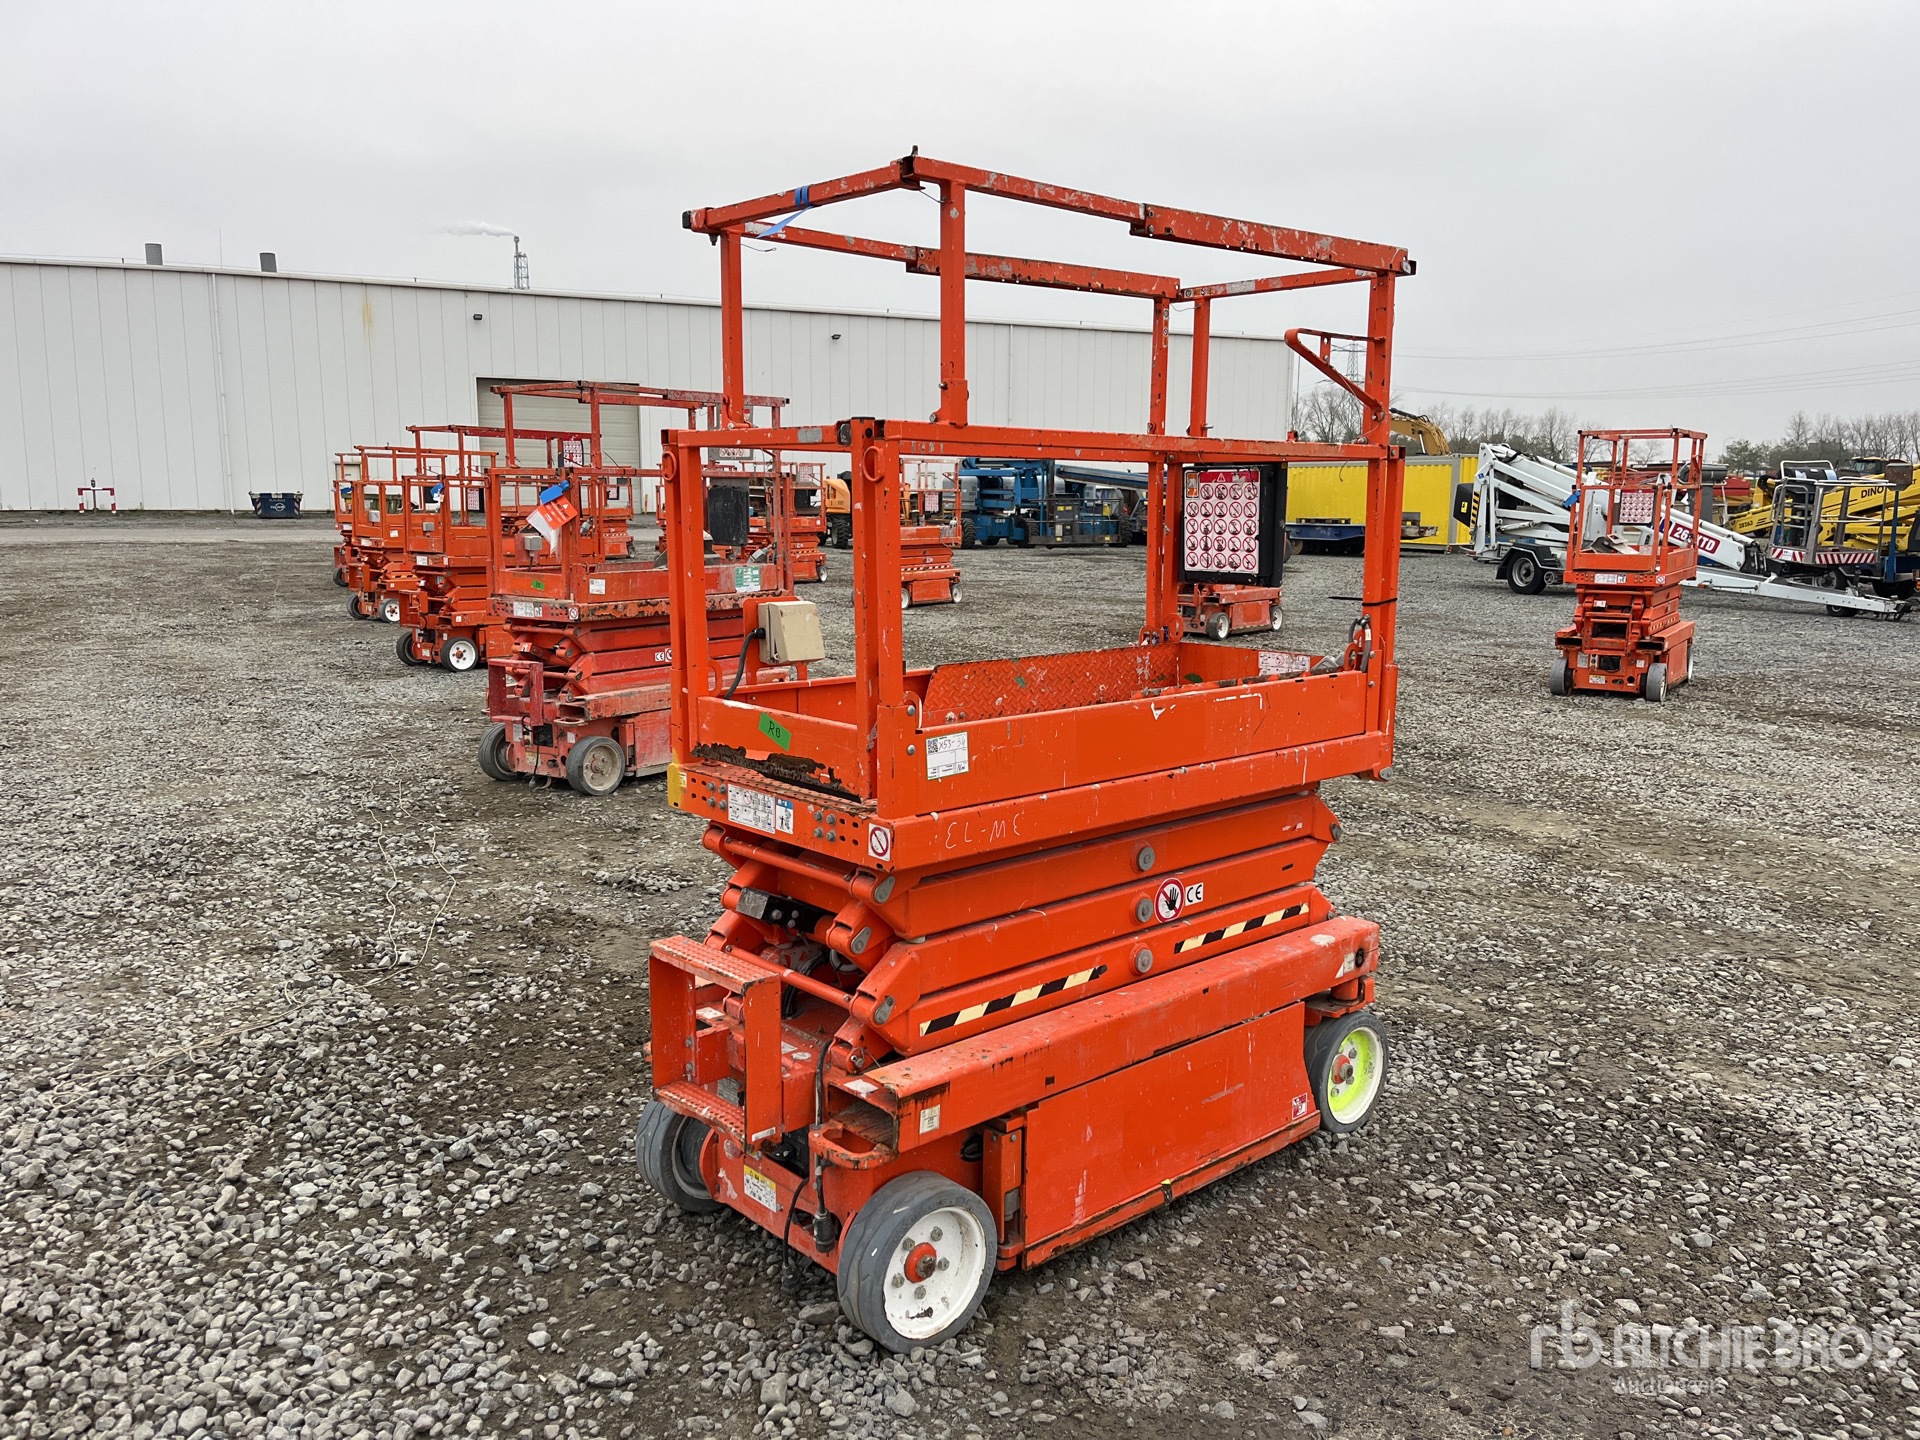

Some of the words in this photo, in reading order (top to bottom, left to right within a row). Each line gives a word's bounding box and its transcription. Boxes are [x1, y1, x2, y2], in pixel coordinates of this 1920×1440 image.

[1861, 486, 1885, 499] DINO
[1673, 526, 1716, 551] 26XTD
[768, 720, 781, 739] RB
[1186, 884, 1203, 903] CE
